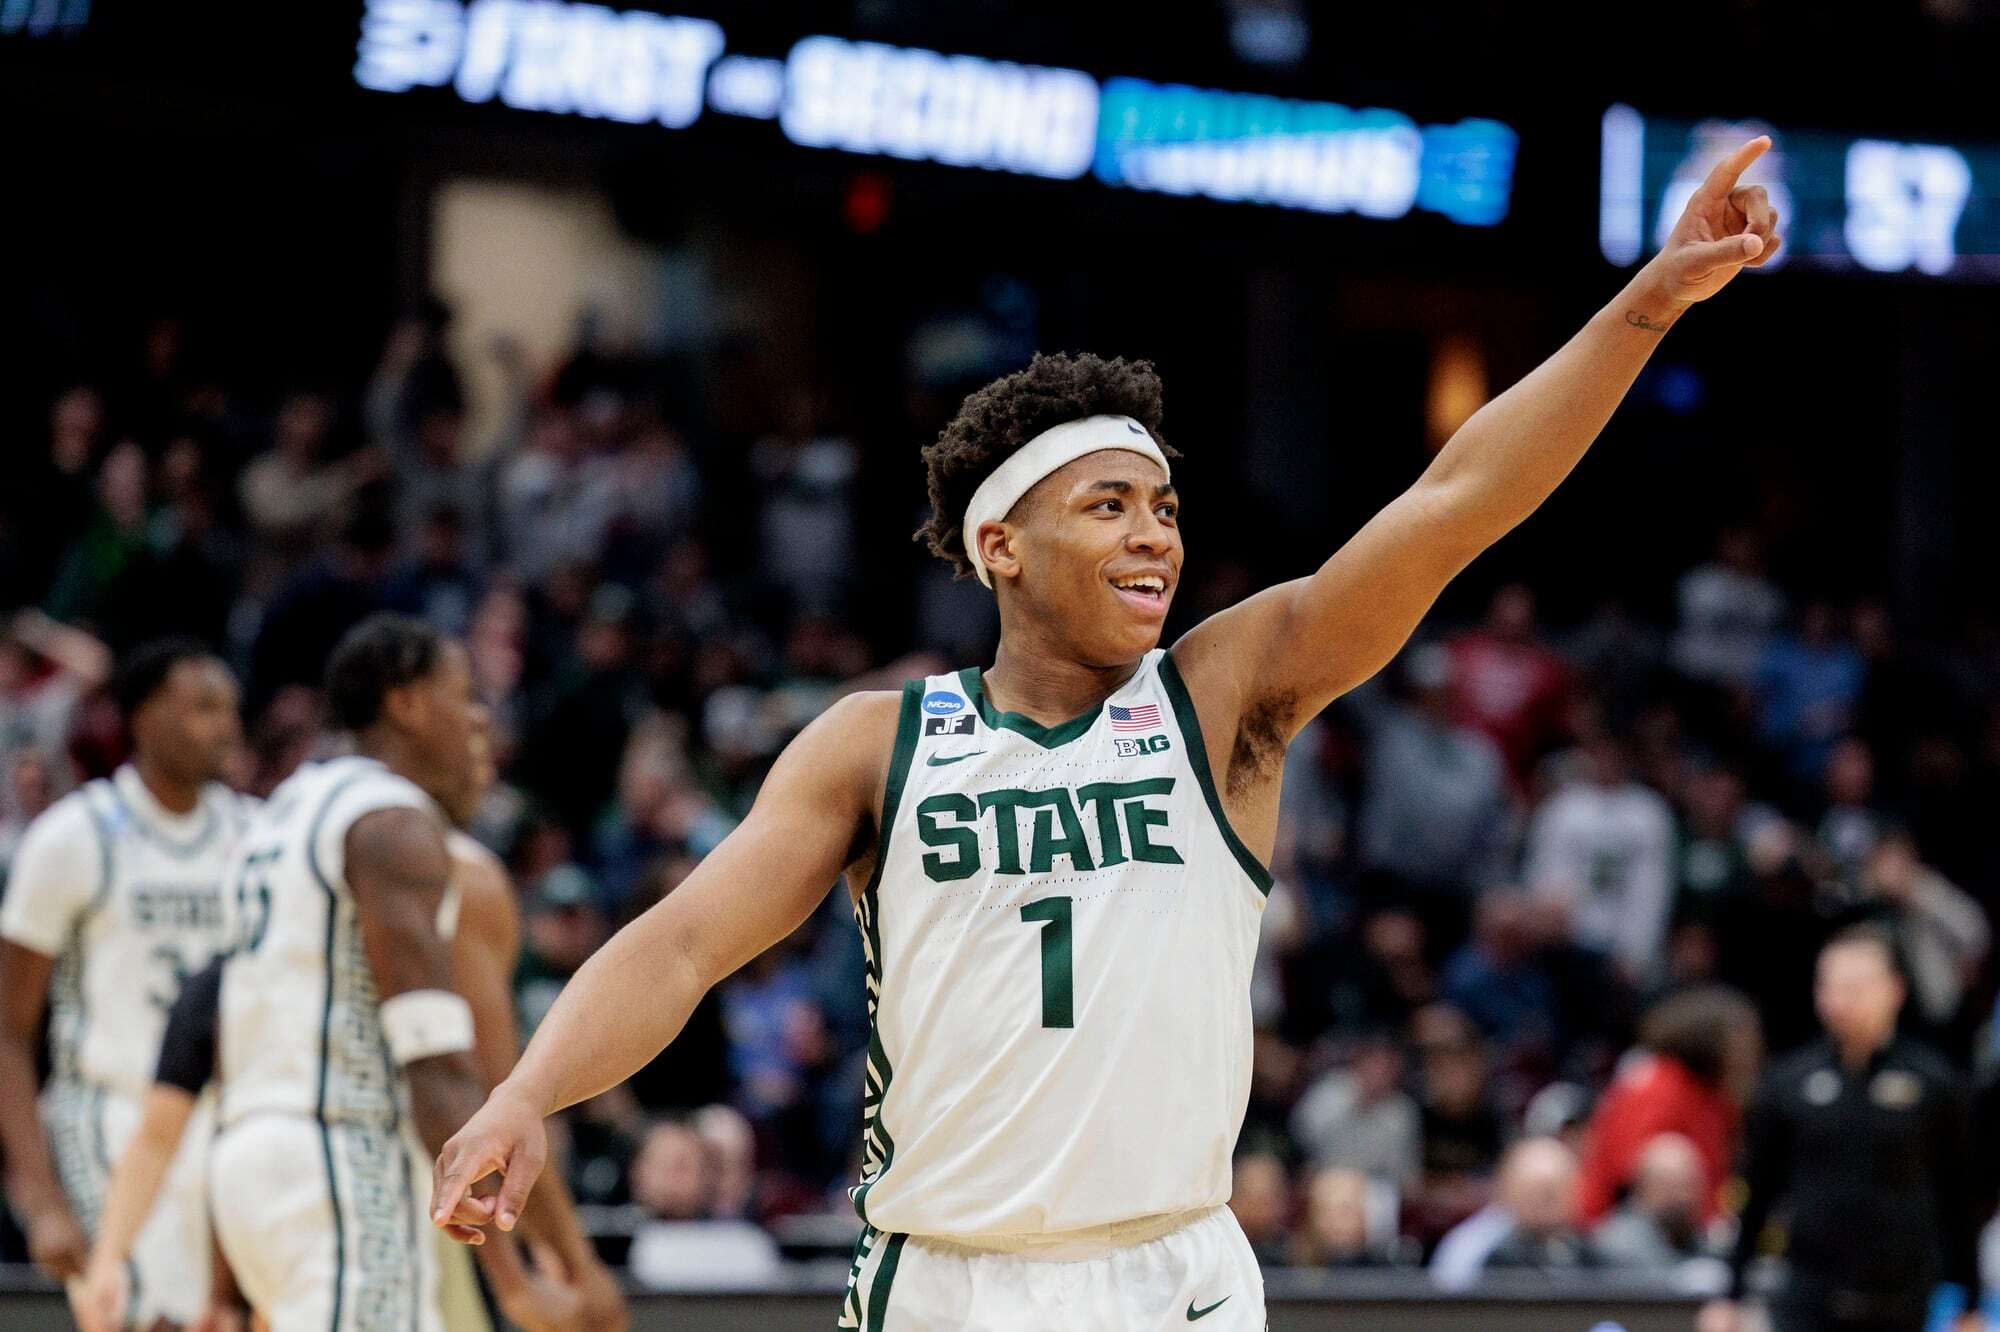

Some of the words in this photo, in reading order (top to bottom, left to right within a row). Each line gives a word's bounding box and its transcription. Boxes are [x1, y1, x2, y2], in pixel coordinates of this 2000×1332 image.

[926, 700, 961, 709] NCAA
[935, 715, 967, 734] JF
[917, 777, 1184, 883] STATE
[1020, 896, 1074, 1028] 1
